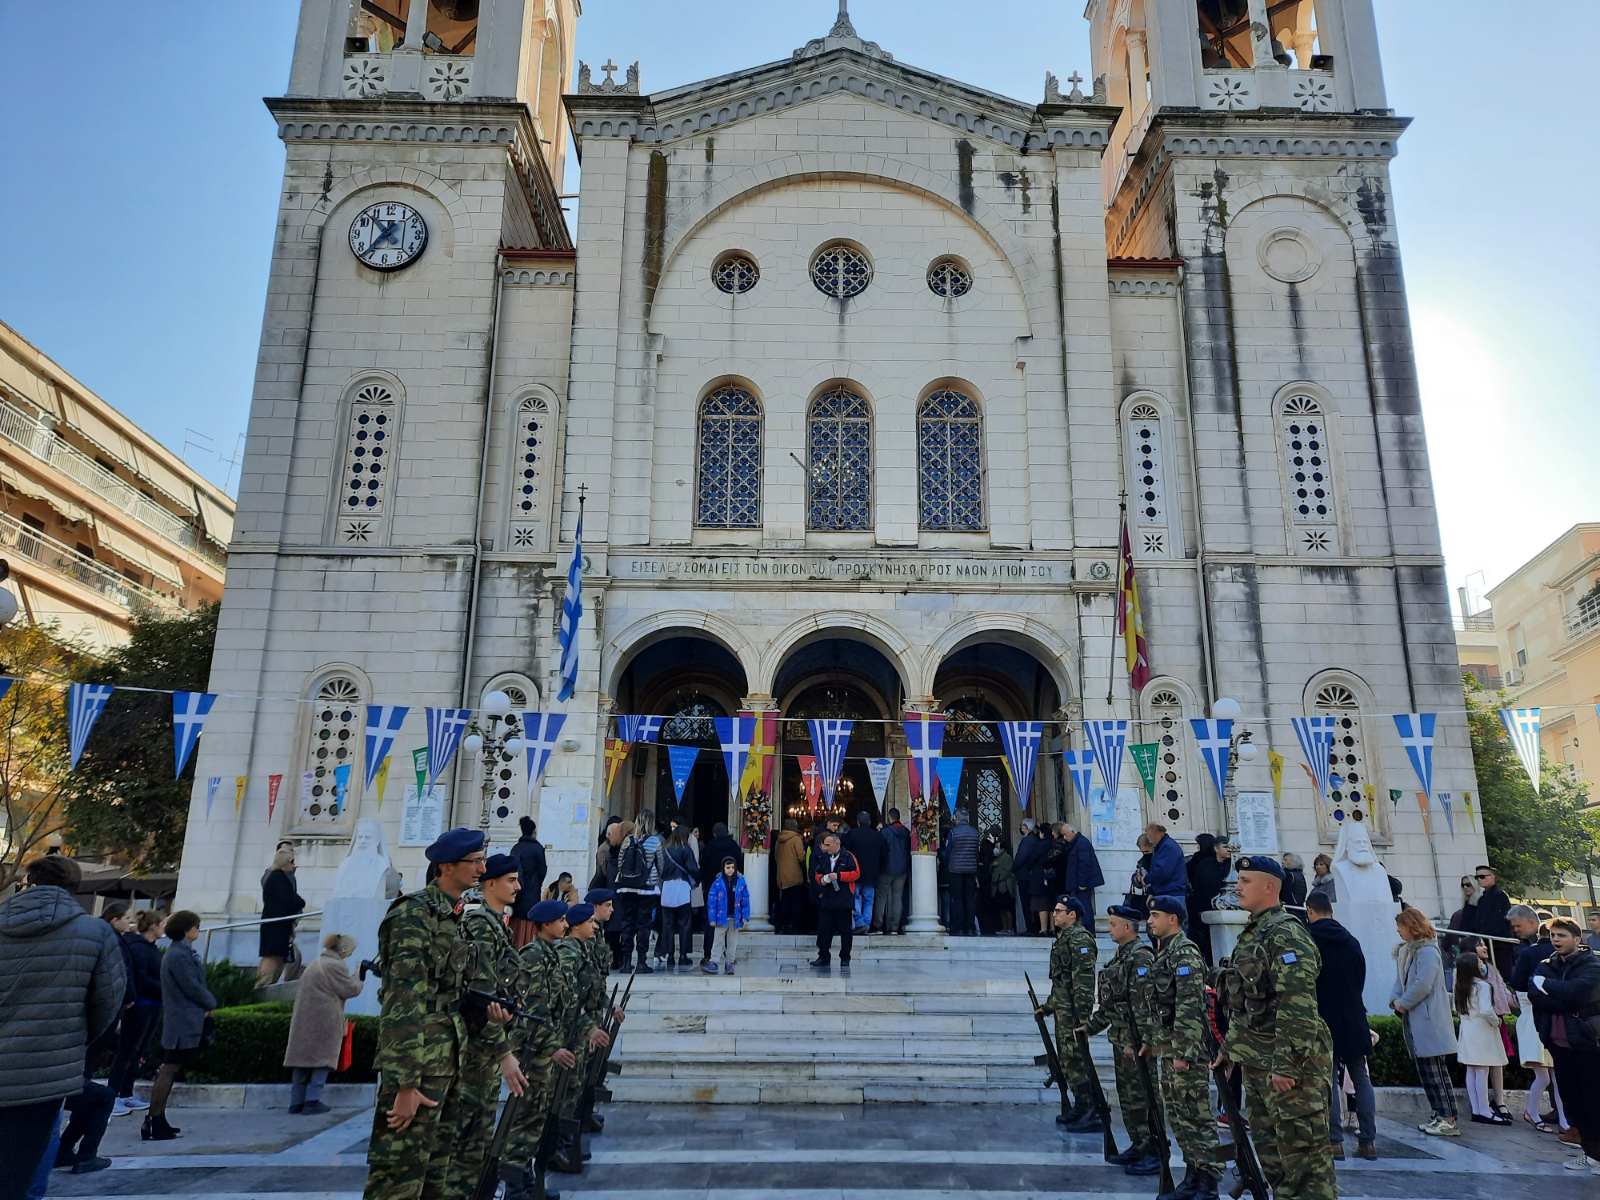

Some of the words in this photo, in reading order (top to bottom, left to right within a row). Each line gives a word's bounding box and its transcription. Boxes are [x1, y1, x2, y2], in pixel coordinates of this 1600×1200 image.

[373, 209, 380, 219] 11
[386, 205, 397, 216] 12
[412, 217, 419, 228] 2
[354, 229, 360, 239] 9
[415, 230, 421, 240] 3
[358, 241, 365, 252] 8
[408, 242, 415, 253] 4
[382, 254, 388, 264] 6
[397, 251, 403, 262] 5
[745, 563, 768, 575] ΤΟΝ
[837, 563, 917, 576] ΠΡΟΣΚΥΝΗΣΩ
[920, 564, 952, 576] ΠΡΟΣ
[956, 564, 988, 577] ΝΑΟΝ
